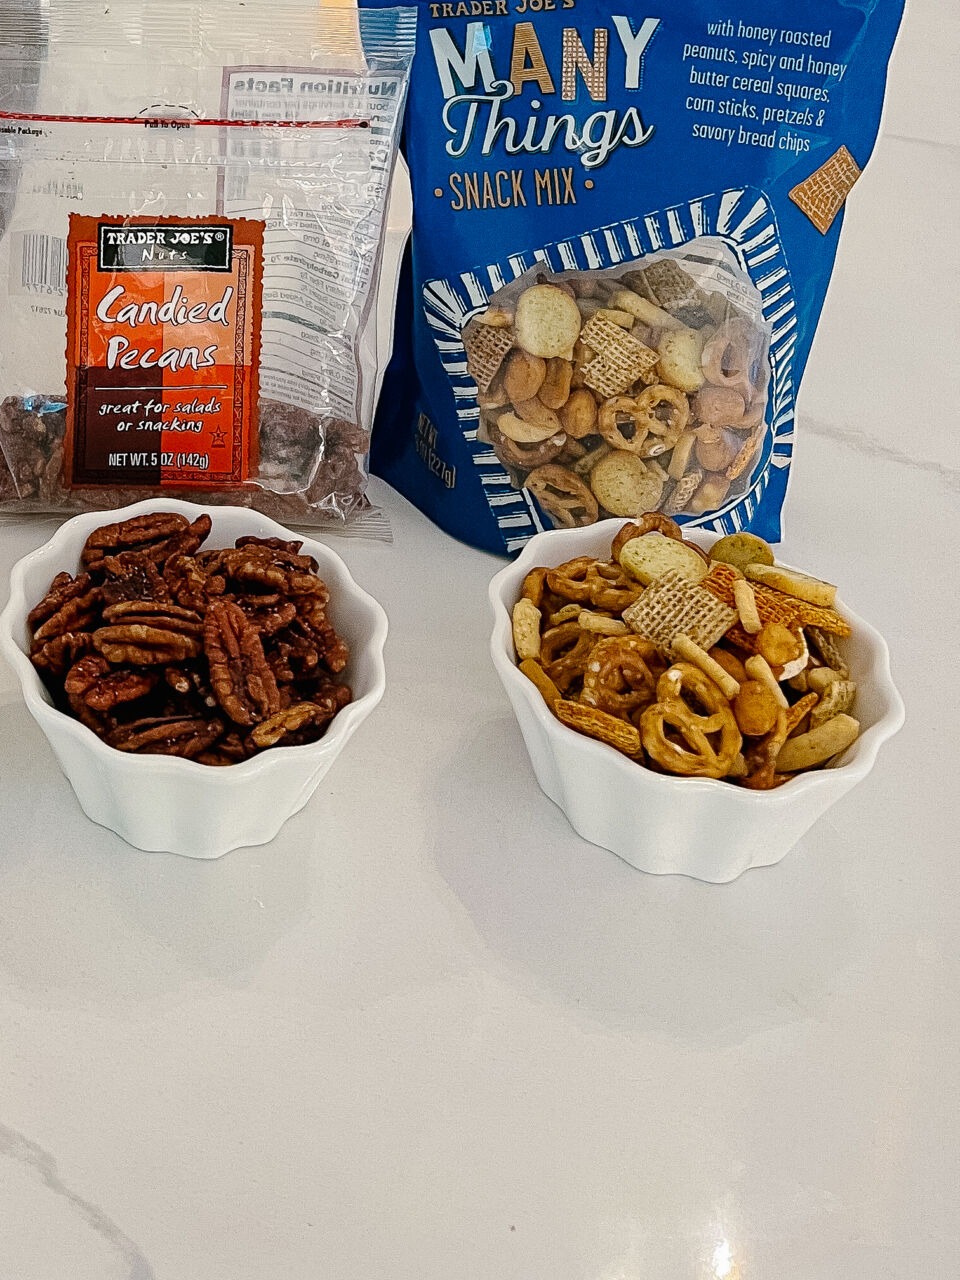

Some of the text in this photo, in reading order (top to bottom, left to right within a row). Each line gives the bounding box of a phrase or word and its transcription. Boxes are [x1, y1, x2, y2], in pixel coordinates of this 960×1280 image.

[429, 0, 509, 18] TRADER
[707, 19, 832, 49] with honey roasted
[428, 15, 662, 102] MANY
[682, 43, 848, 82] peanuts, spicy and honey
[689, 65, 730, 88] butter
[732, 76, 774, 94] cereal
[442, 79, 655, 168] Things
[685, 95, 715, 113] corn
[762, 107, 814, 126] pretzels
[815, 109, 826, 127] &
[692, 123, 811, 157] savory bread chips
[448, 166, 577, 211] SNACK MIX
[106, 232, 166, 245] TRADER
[141, 247, 187, 262] Nuts
[96, 284, 234, 327] Candied
[105, 334, 218, 373] Pecans
[98, 396, 222, 417] great for salads
[116, 416, 204, 433] or snacking
[108, 452, 210, 469] NET WT. 5 OZ (142g)
